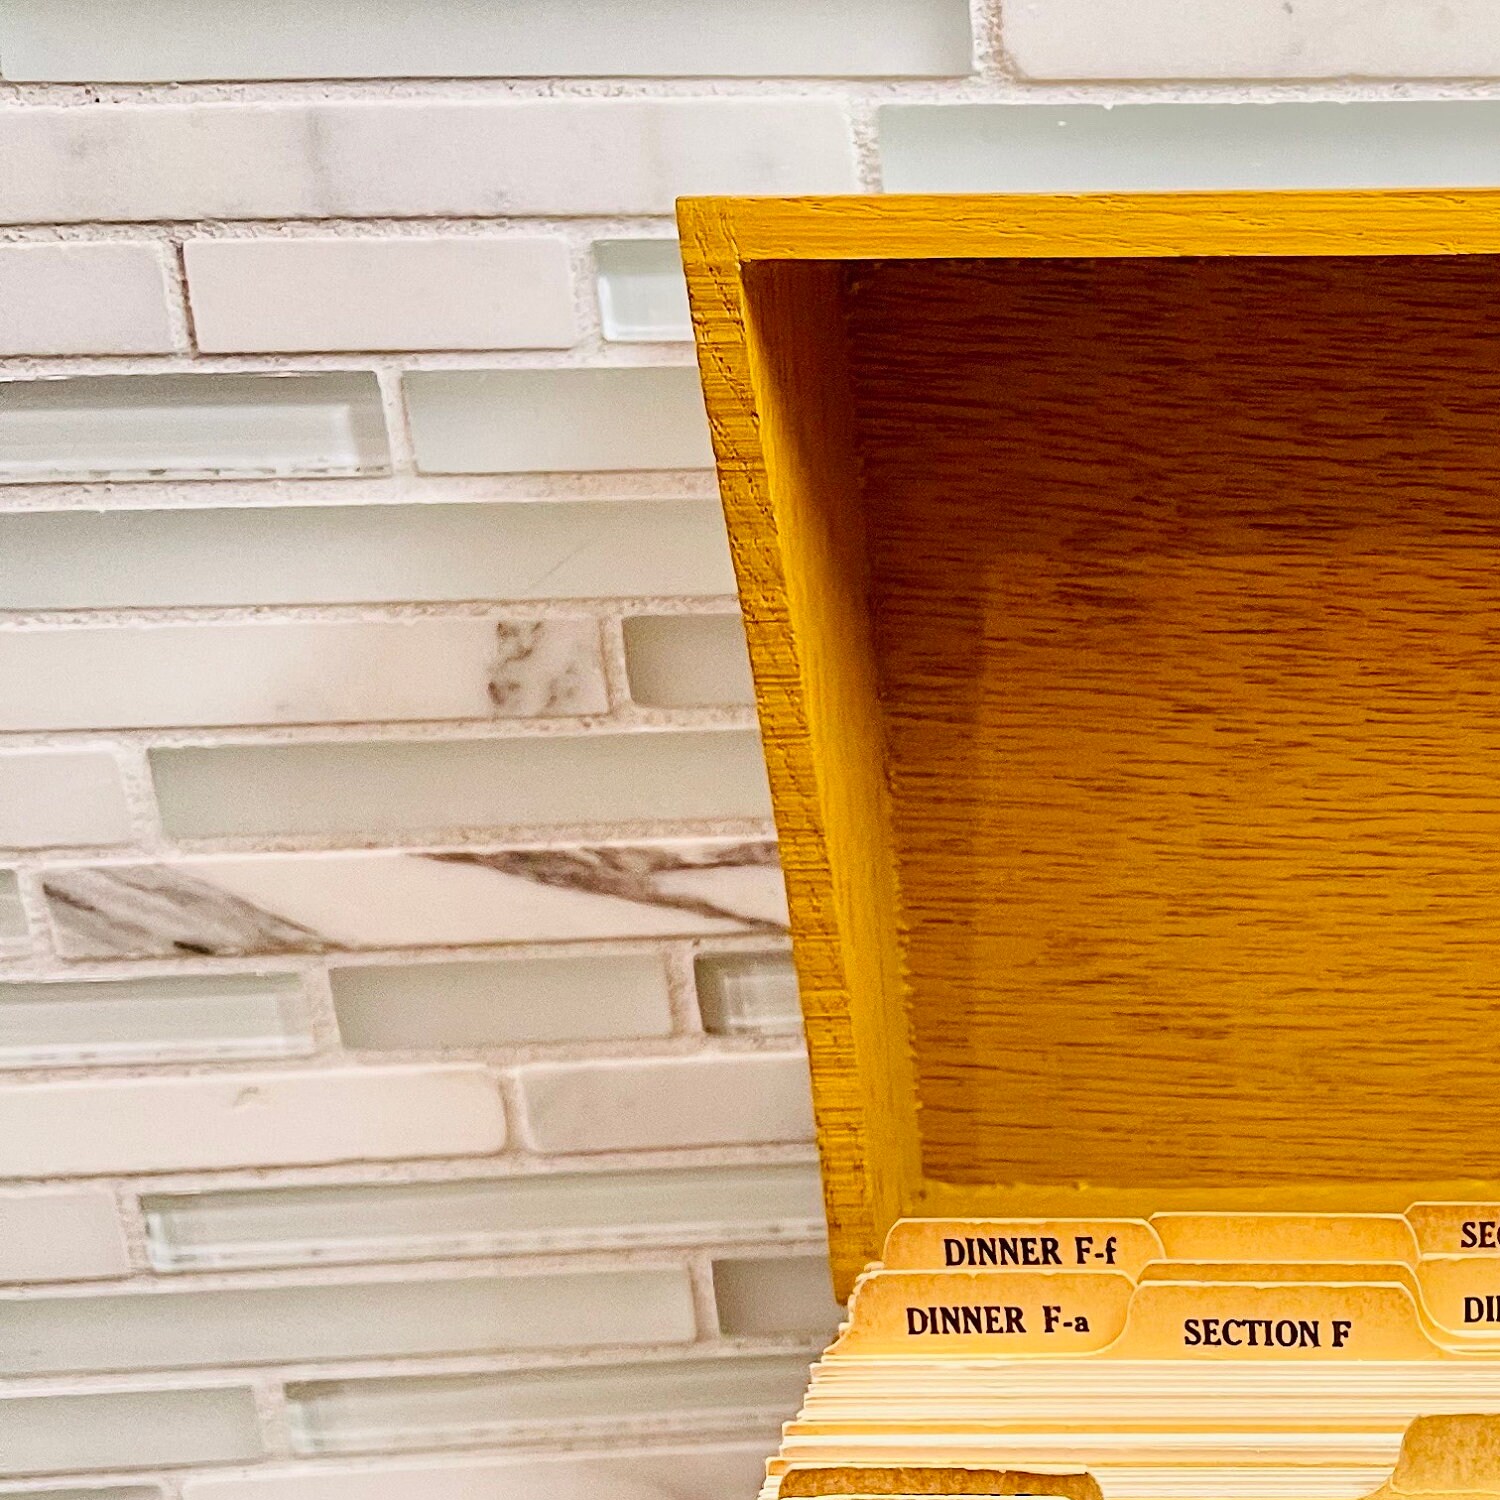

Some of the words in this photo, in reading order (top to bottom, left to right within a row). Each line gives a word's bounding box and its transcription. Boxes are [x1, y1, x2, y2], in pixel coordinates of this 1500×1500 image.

[943, 1237, 1063, 1267] DINNER
[1074, 1236, 1117, 1265] F-f
[906, 1305, 1027, 1335] DINNER
[1042, 1305, 1090, 1333] F-a
[1184, 1318, 1321, 1348] SECTION
[1331, 1320, 1352, 1348] F
